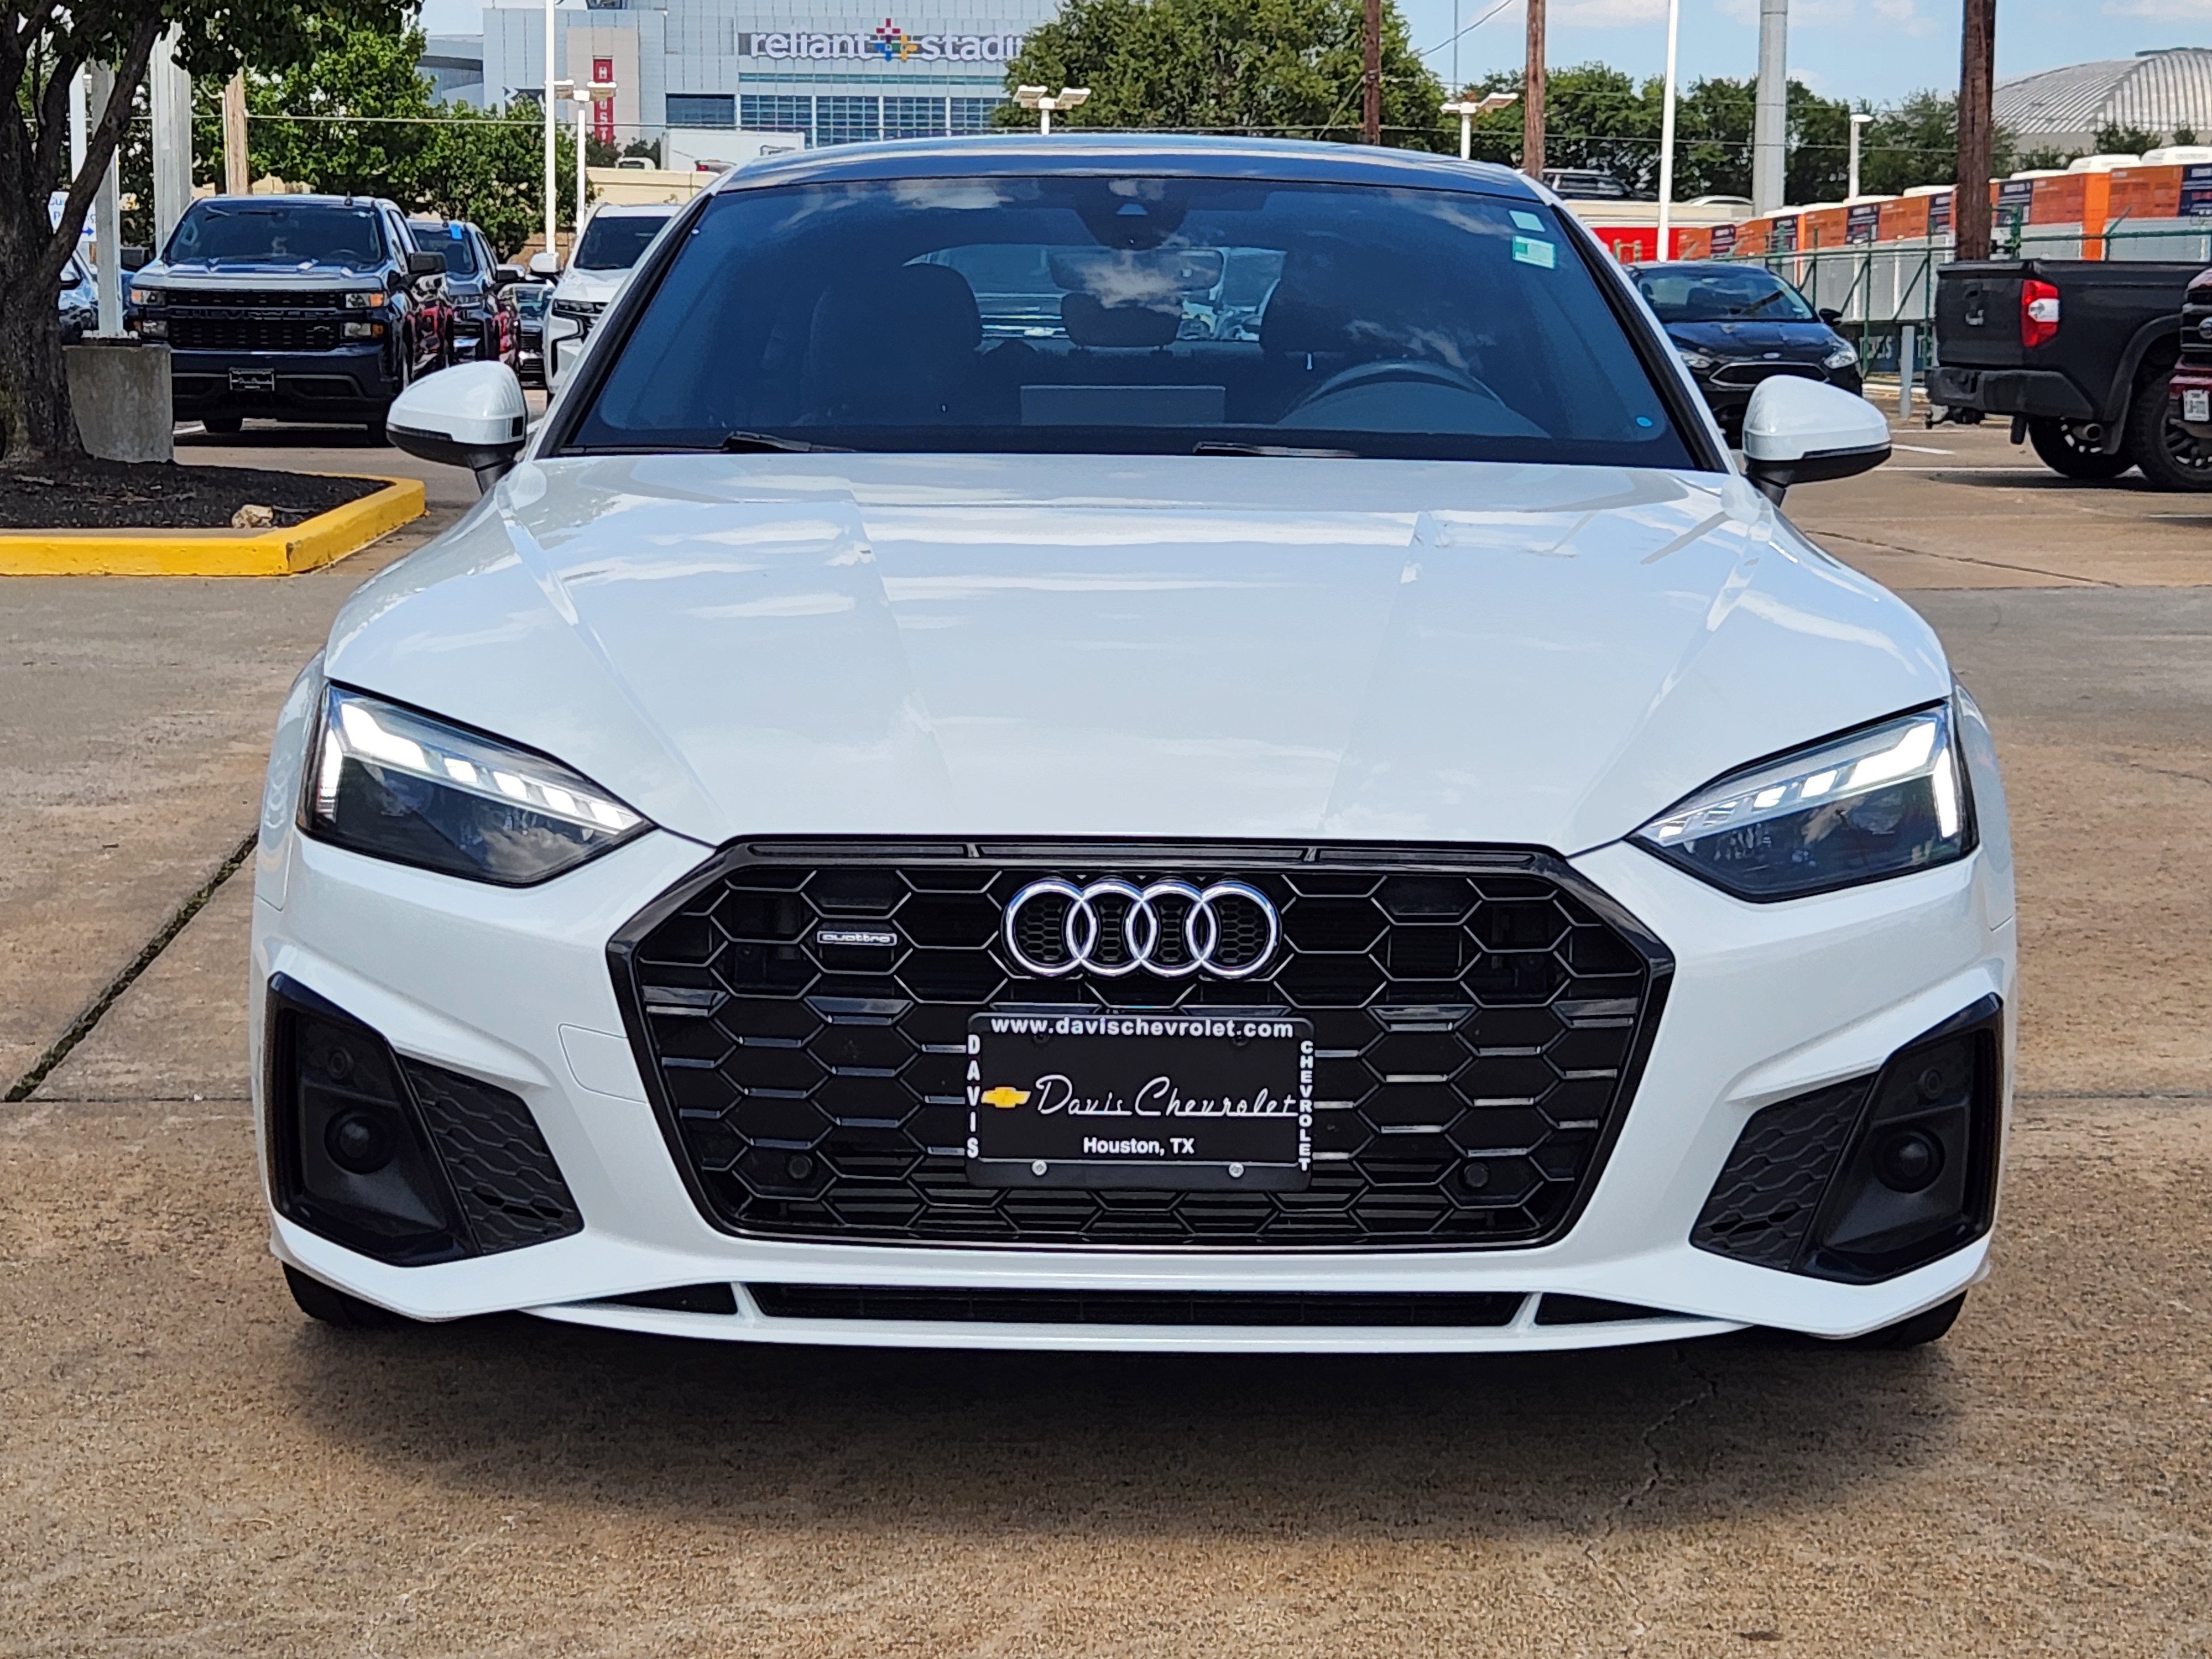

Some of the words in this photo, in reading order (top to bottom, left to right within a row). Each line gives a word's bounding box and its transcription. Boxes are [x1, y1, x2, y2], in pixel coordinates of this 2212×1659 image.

[750, 27, 873, 59] reliant
[822, 933, 891, 943] quattro
[991, 1016, 1293, 1038] www.davischevrolet.com
[967, 1034, 981, 1159] DAVIS
[1035, 1074, 1133, 1116] Davis
[1134, 1076, 1299, 1117] Chevrolet
[1298, 1040, 1314, 1172] CHEVROLET
[1083, 1137, 1165, 1156] Houston,
[1170, 1138, 1195, 1155] TX
